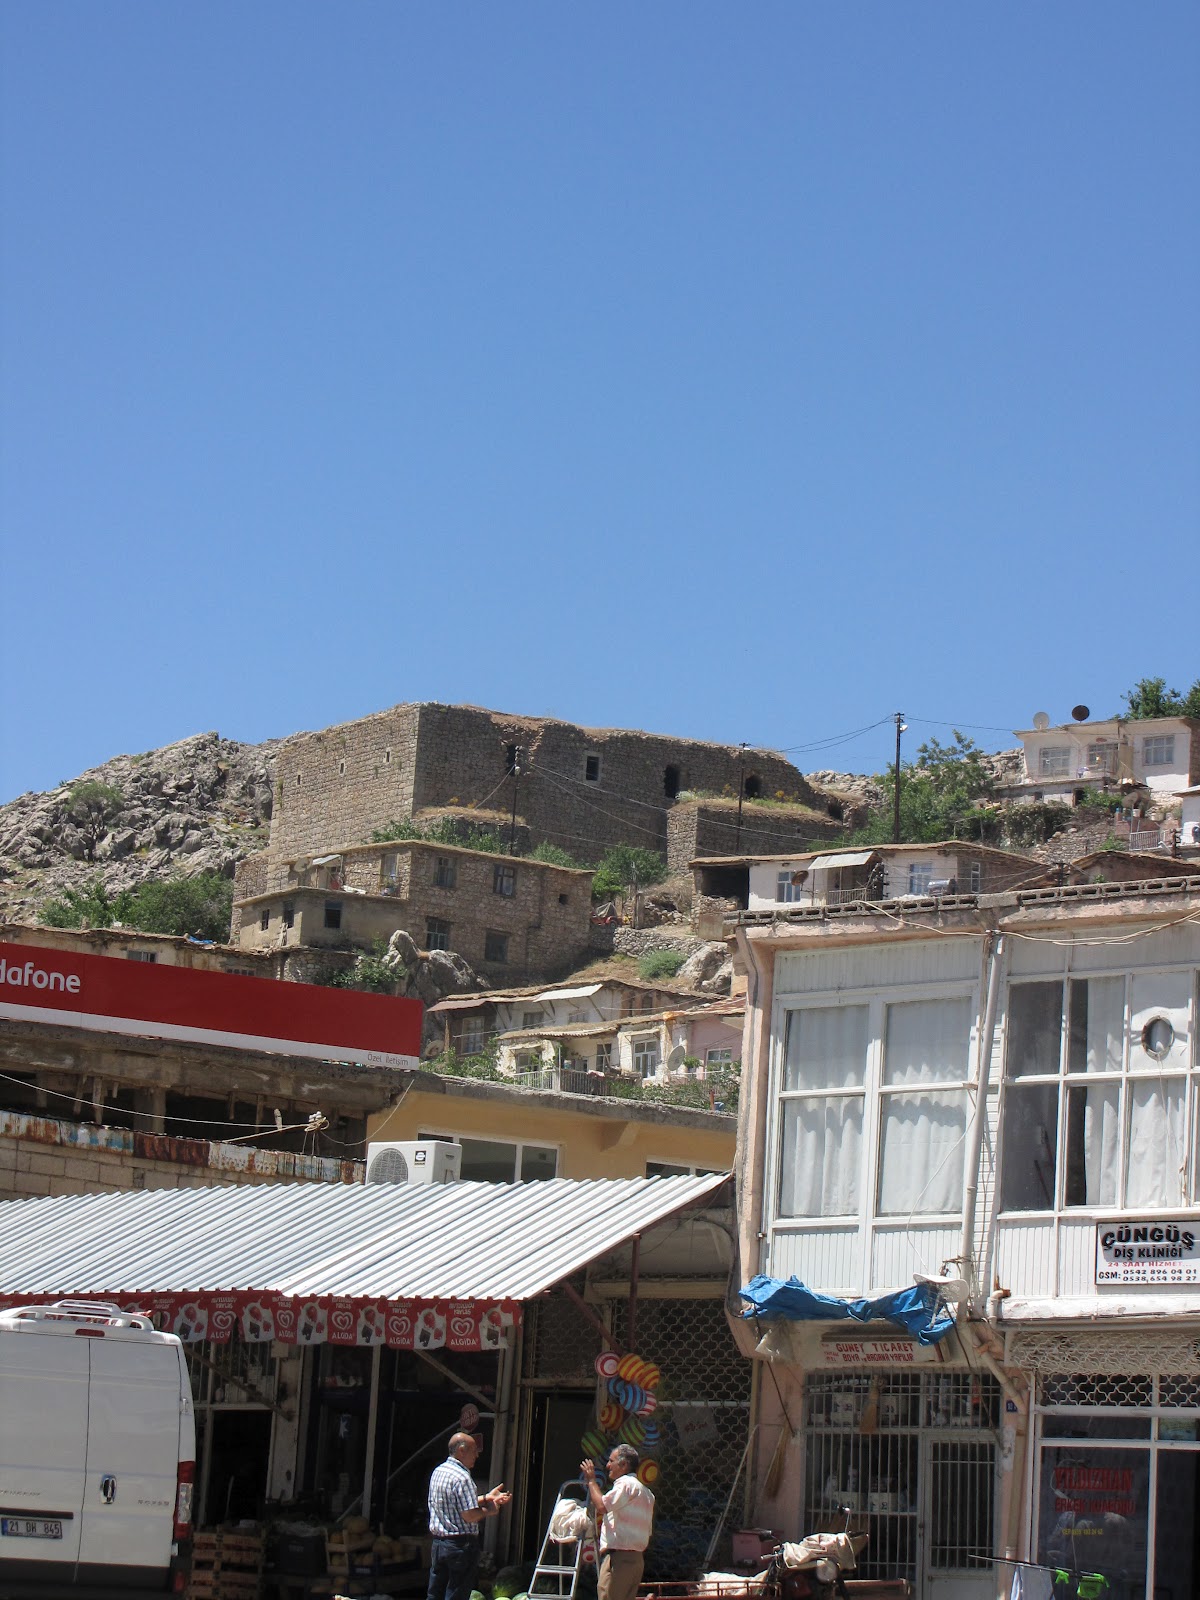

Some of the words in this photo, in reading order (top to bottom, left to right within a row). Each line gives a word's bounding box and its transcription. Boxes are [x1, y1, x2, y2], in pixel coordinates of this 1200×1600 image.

[367, 1052, 382, 1063] Özel
[1100, 1225, 1195, 1251] ÇÜNGÜŞ
[1114, 1245, 1134, 1261] DİŞ
[1138, 1244, 1183, 1258] KLİNİĞİ
[1098, 1271, 1121, 1280] GSM:
[842, 1353, 860, 1362] BOYA
[1054, 1467, 1133, 1491] YILDIZHAN
[1055, 1497, 1086, 1514] ERKEK
[9, 1521, 19, 1532] 21
[26, 1522, 37, 1533] DH
[43, 1523, 60, 1535] 845
